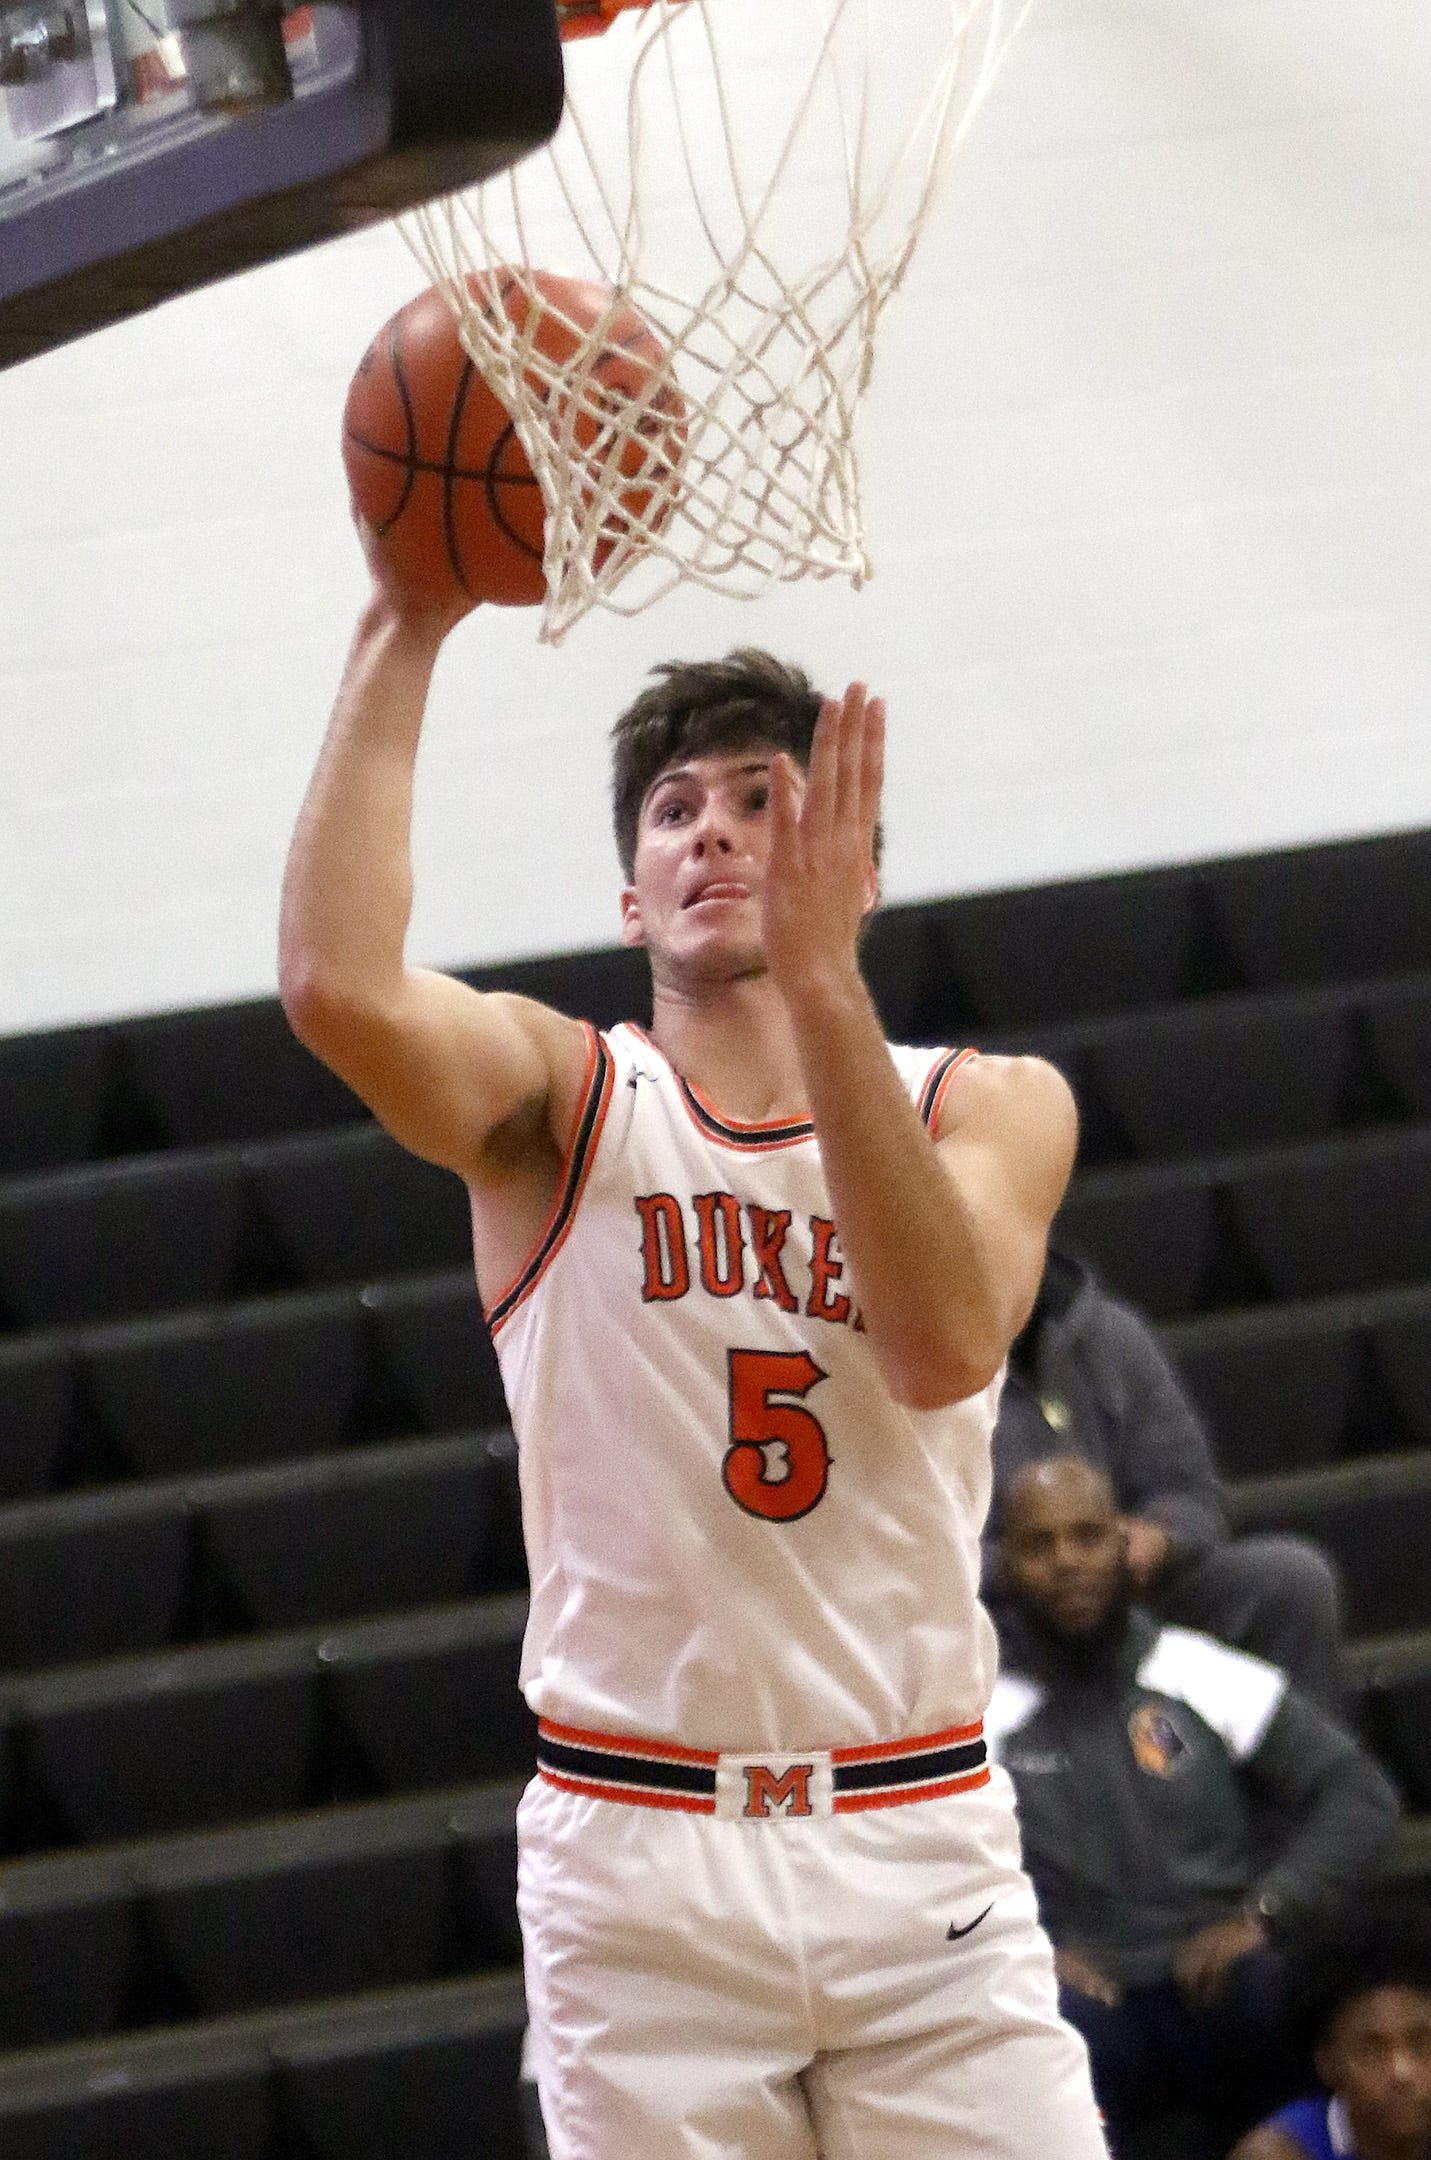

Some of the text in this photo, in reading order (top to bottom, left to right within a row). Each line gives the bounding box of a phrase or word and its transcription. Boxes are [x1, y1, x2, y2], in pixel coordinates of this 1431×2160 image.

[634, 1191, 866, 1334] DUKE
[721, 1348, 834, 1523] 5
[743, 1764, 813, 1817] M
